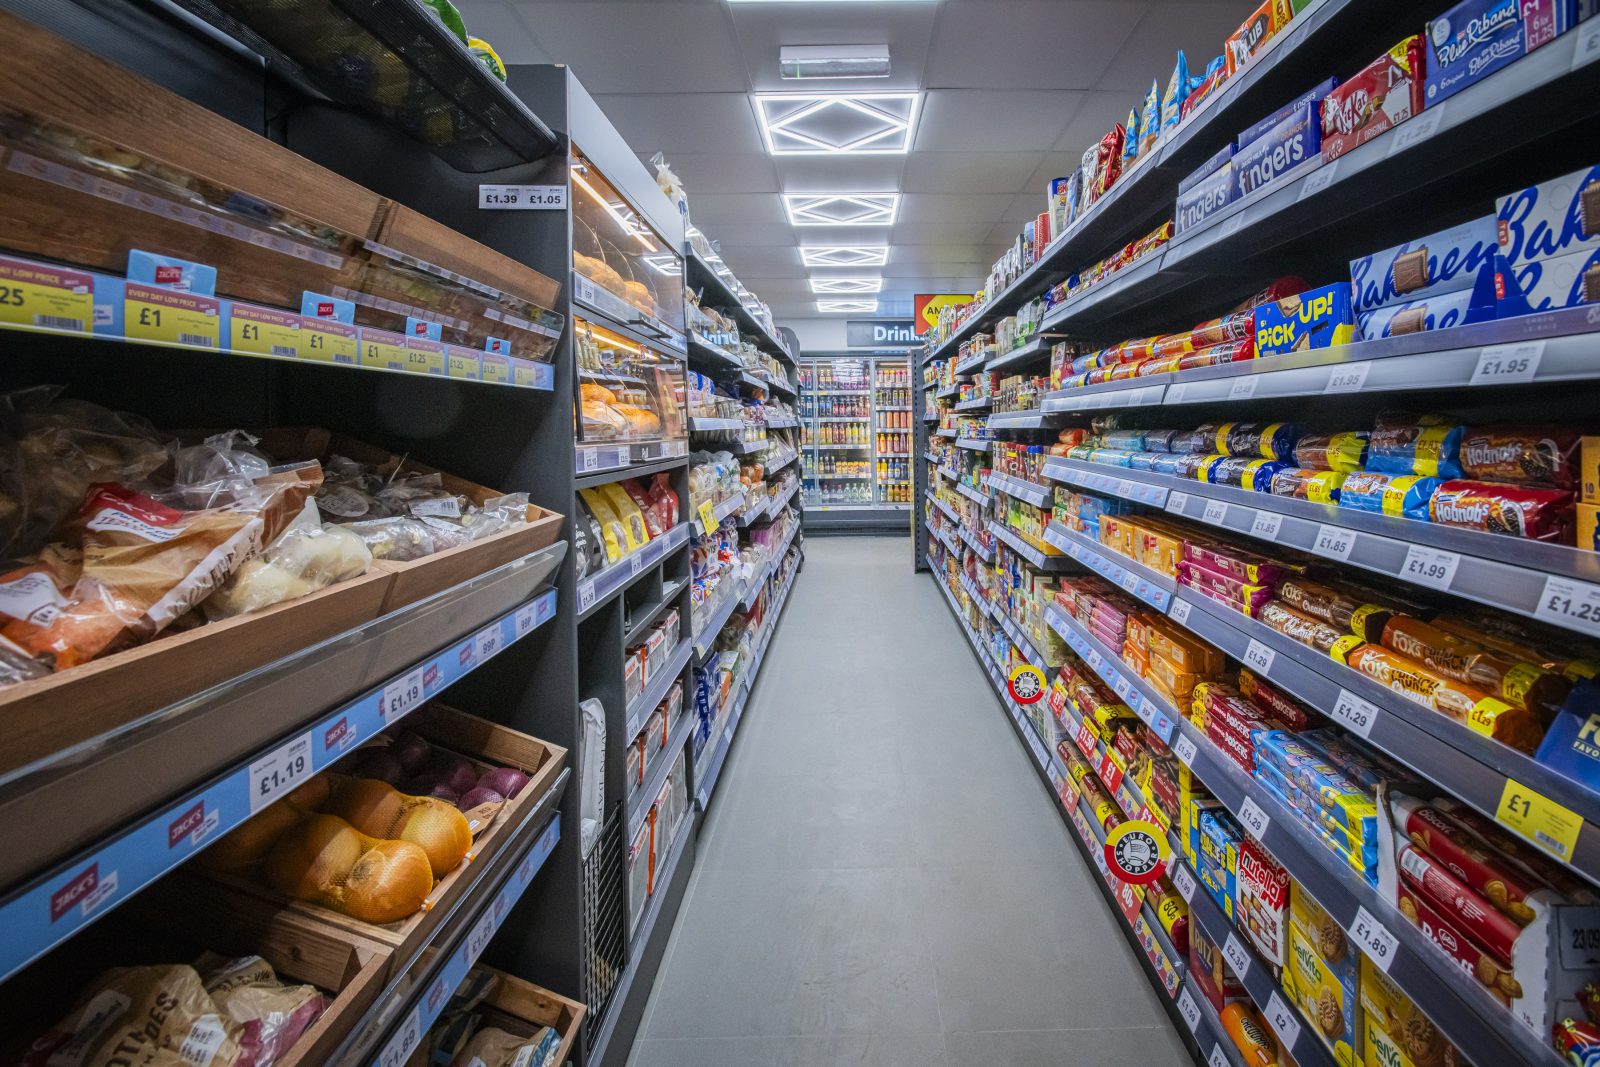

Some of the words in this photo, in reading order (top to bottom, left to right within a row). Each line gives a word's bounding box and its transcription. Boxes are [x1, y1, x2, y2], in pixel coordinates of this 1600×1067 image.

[1533, 17, 1539, 29] 6
[1438, 39, 1467, 69] Blue
[1467, 2, 1517, 42] Riband
[1529, 24, 1553, 49] £1.25
[1239, 134, 1303, 197] fingers
[486, 194, 517, 204] £1.39
[529, 195, 561, 204] £1.05
[1180, 183, 1226, 232] fingers
[128, 288, 149, 299] EVERY
[164, 295, 178, 304] LOW
[139, 307, 161, 327] £1
[1299, 292, 1333, 324] UP!
[242, 324, 258, 340] £1
[310, 334, 323, 349] £1
[874, 326, 924, 342] Drink
[409, 353, 426, 363] £1.25
[1481, 359, 1530, 375] £1.95
[1332, 375, 1360, 387] £1.95
[1465, 442, 1522, 466] Hobnobs
[1435, 502, 1489, 523] Hobnobs
[1255, 522, 1275, 534] £1.85
[1320, 537, 1347, 553] £1.85
[1408, 560, 1446, 579] £1.99
[1547, 596, 1600, 624] £1.25
[1248, 651, 1267, 667] £1.29
[391, 686, 418, 712] £1.19
[1339, 704, 1367, 727] £1.29
[327, 723, 346, 744] JACK'S
[260, 755, 305, 797] £1.19
[1507, 794, 1532, 818] £1
[171, 810, 202, 840] JACK'S
[1242, 808, 1262, 831] £1.29
[1123, 832, 1153, 846] EURO
[1116, 850, 1158, 873] SHOPPER
[1242, 852, 1279, 899] nutella
[54, 872, 96, 912] JACK'S
[1163, 900, 1178, 920] 80p
[1356, 924, 1387, 957] £1.89
[1227, 945, 1244, 971] £2.35
[1276, 1017, 1287, 1032] £2
